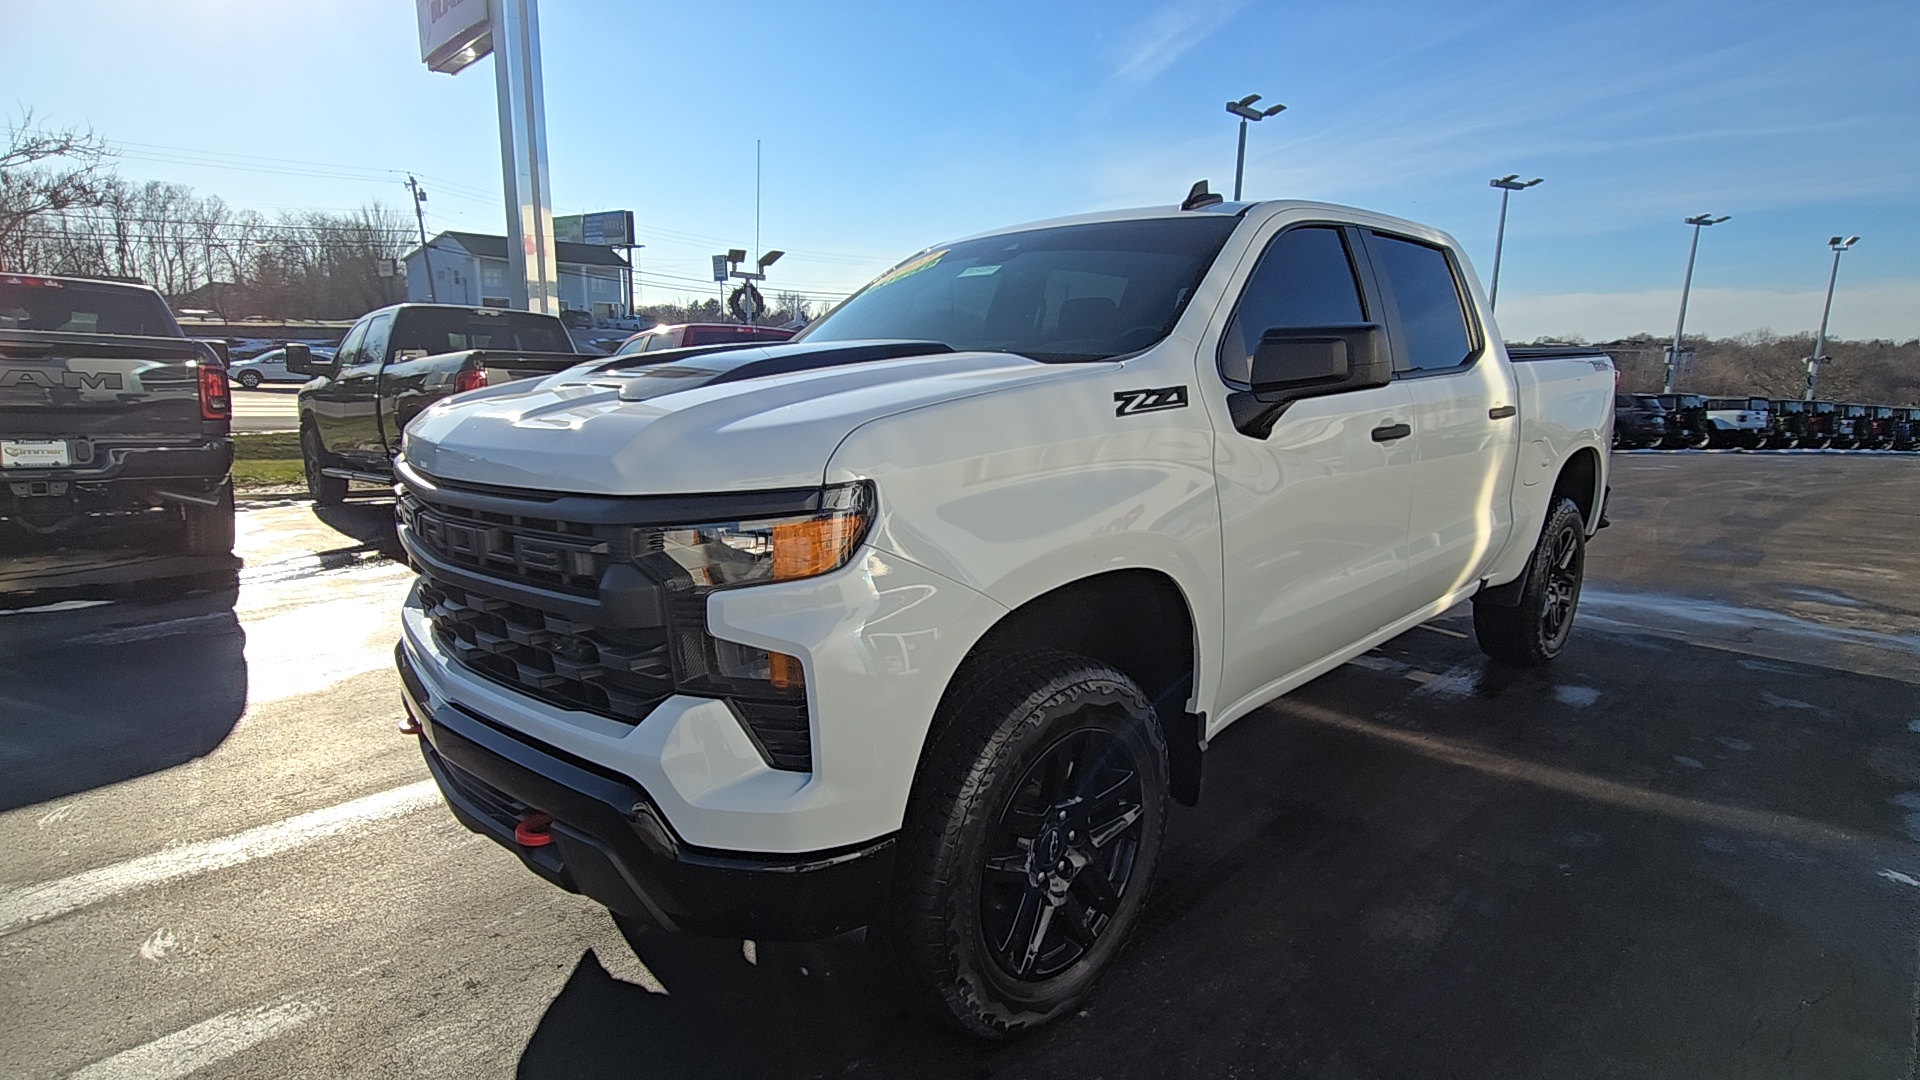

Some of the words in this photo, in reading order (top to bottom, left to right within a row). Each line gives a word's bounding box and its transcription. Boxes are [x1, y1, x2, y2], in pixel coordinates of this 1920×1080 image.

[0, 370, 123, 389] AM
[1113, 385, 1189, 417] Z71
[402, 495, 610, 577] EVROLET
